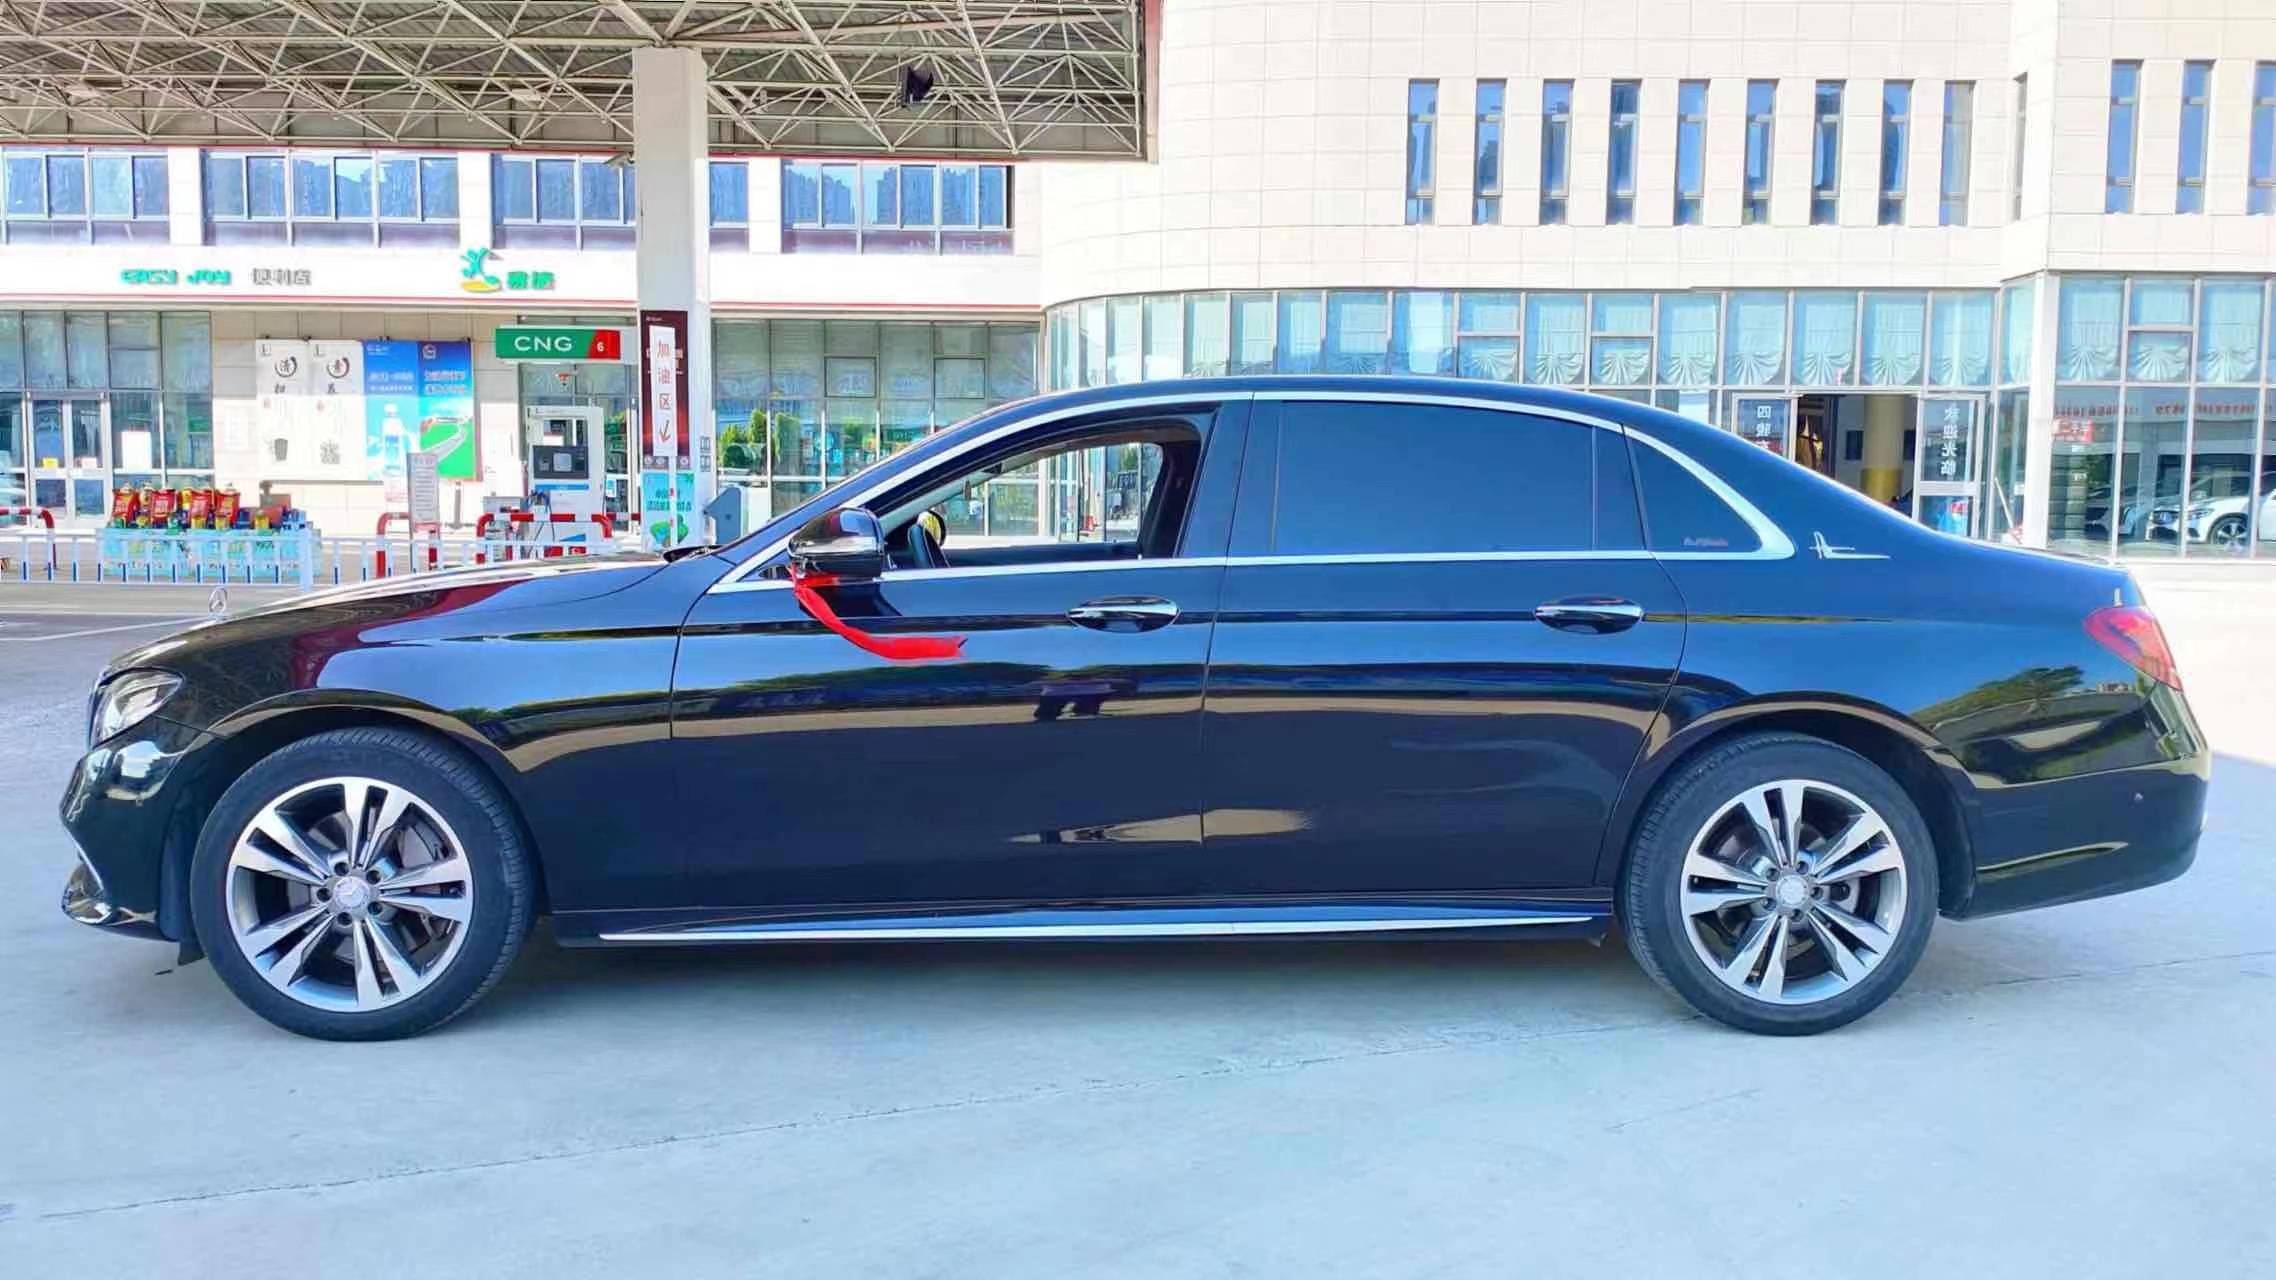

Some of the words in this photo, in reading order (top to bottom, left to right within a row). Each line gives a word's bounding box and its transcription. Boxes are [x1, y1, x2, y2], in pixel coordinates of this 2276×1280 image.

[514, 336, 573, 352] CNG
[596, 343, 605, 353] 6
[656, 338, 672, 411] 加油区
